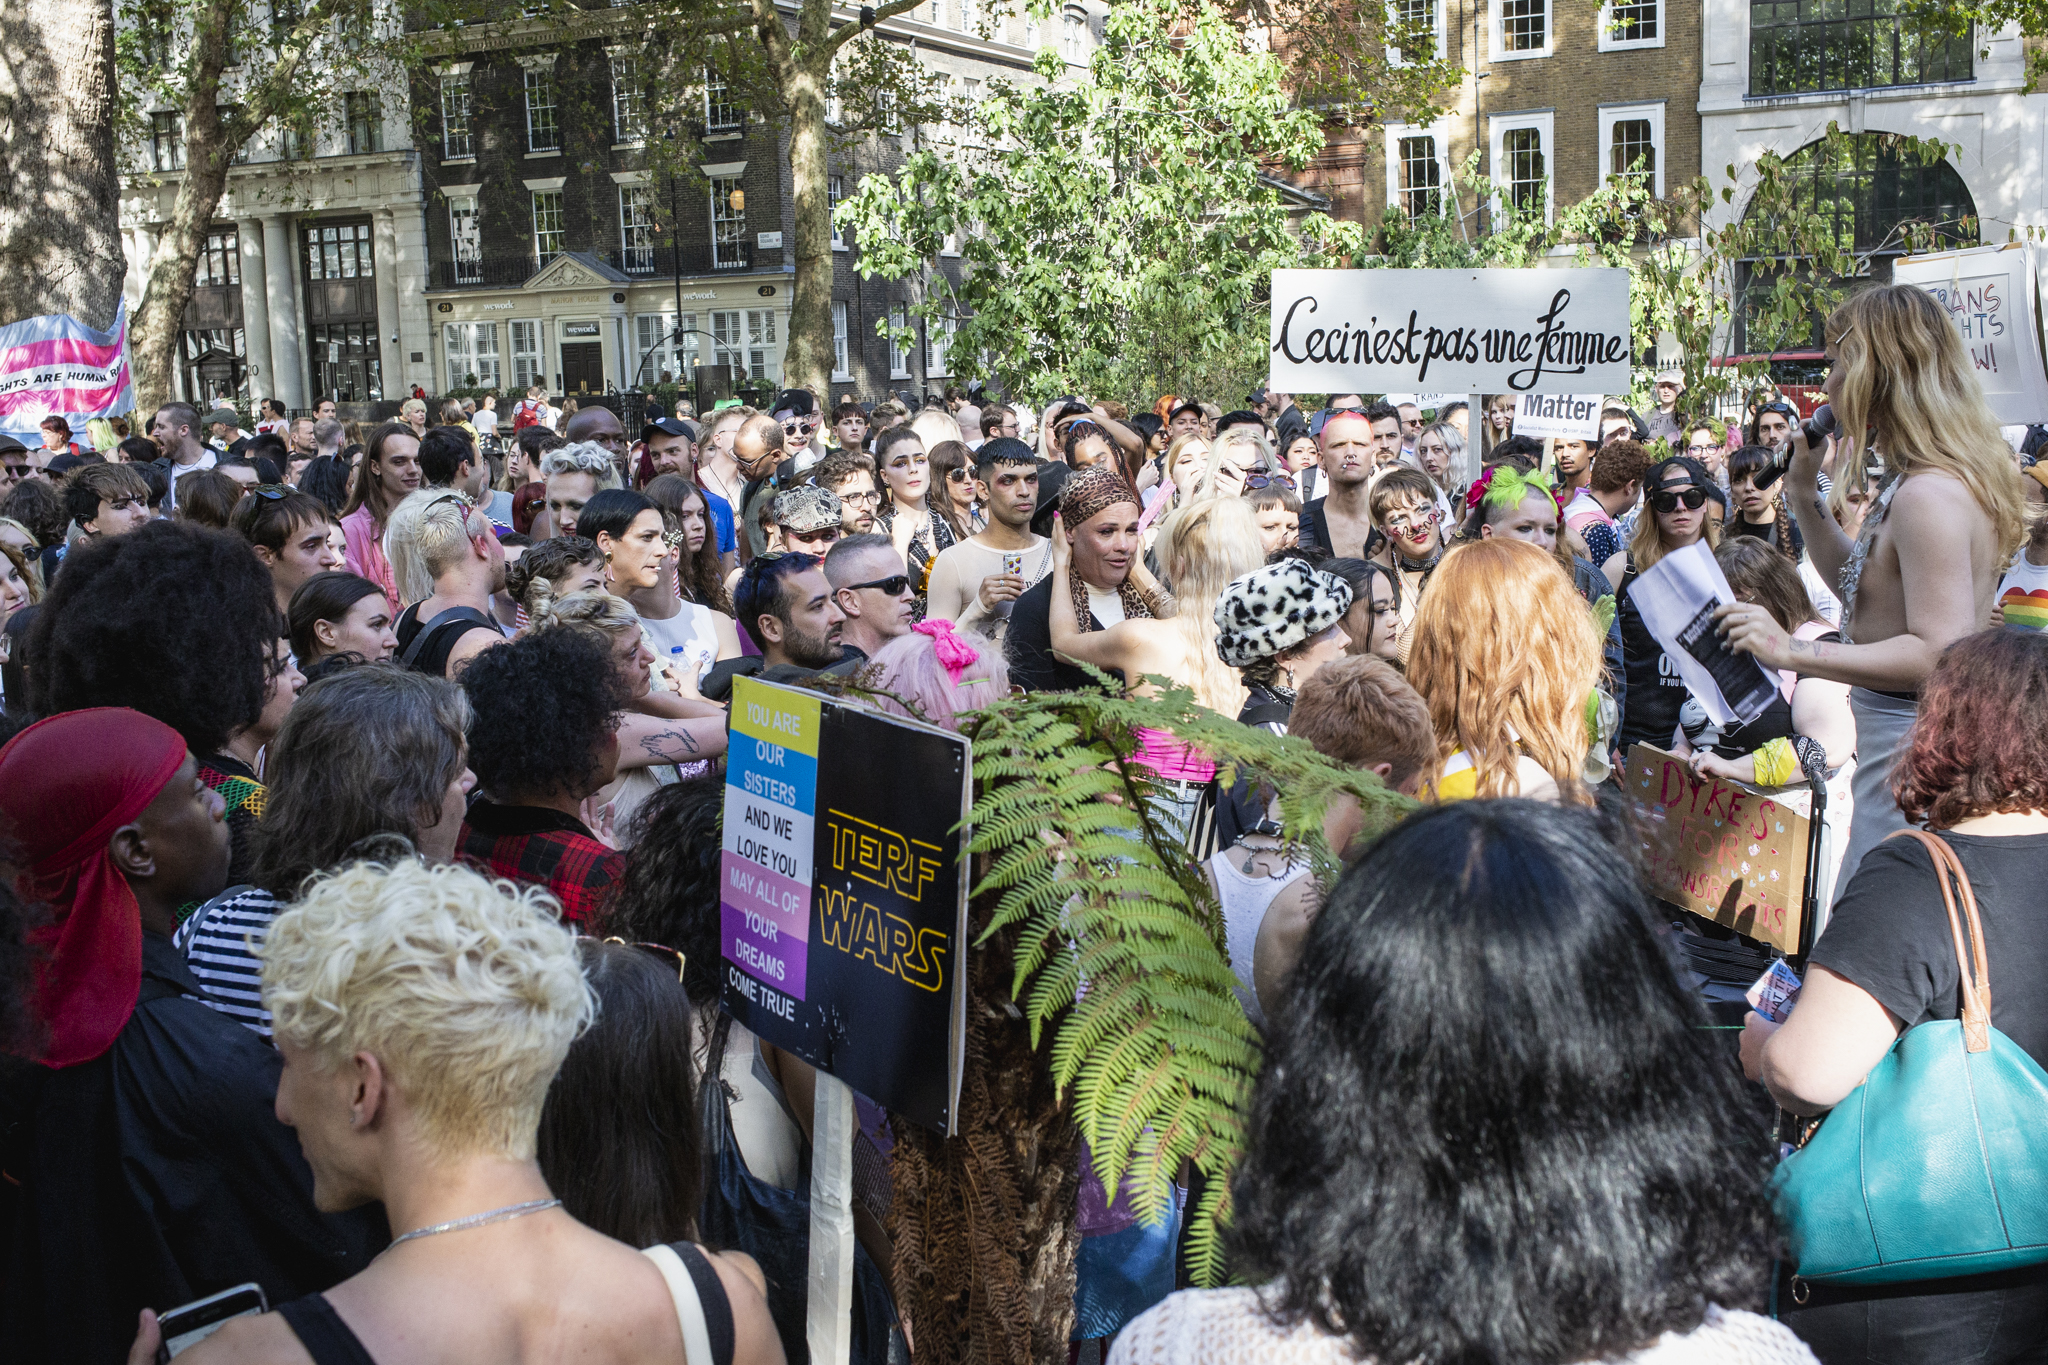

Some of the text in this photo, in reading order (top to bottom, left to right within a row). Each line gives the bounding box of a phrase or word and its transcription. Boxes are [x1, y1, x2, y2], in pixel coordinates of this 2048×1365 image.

[483, 300, 514, 311] wework
[577, 295, 600, 303] HOUSE
[682, 289, 717, 301] wework
[762, 287, 772, 295] 21
[441, 303, 450, 311] 21
[566, 323, 597, 334] wework
[1418, 326, 1479, 382] pas
[1480, 328, 1534, 364] une
[1507, 288, 1628, 391] femme
[1962, 313, 2004, 339] HTS
[247, 364, 259, 376] 20
[1971, 343, 1998, 373] W!
[34, 373, 62, 383] ARE
[67, 371, 107, 383] HUMAN
[1523, 395, 1597, 421] Matter
[1660, 677, 1666, 686] IF
[1667, 678, 1680, 687] YOU
[747, 701, 801, 737] YOU ARE
[756, 740, 785, 768] OUR
[744, 769, 796, 807] SISTERS
[1660, 761, 1776, 840] DYKES
[745, 805, 793, 841] AND WE
[737, 835, 797, 878] LOVE YOU
[828, 808, 942, 901] TERF
[1679, 816, 1738, 869] FOR
[730, 867, 800, 915] MAY ALL OF
[745, 908, 778, 943] YOUR
[819, 884, 947, 992] WARS
[736, 938, 785, 981] DREAMS
[1775, 965, 1788, 990] THE
[729, 966, 795, 1022] COME TRUE
